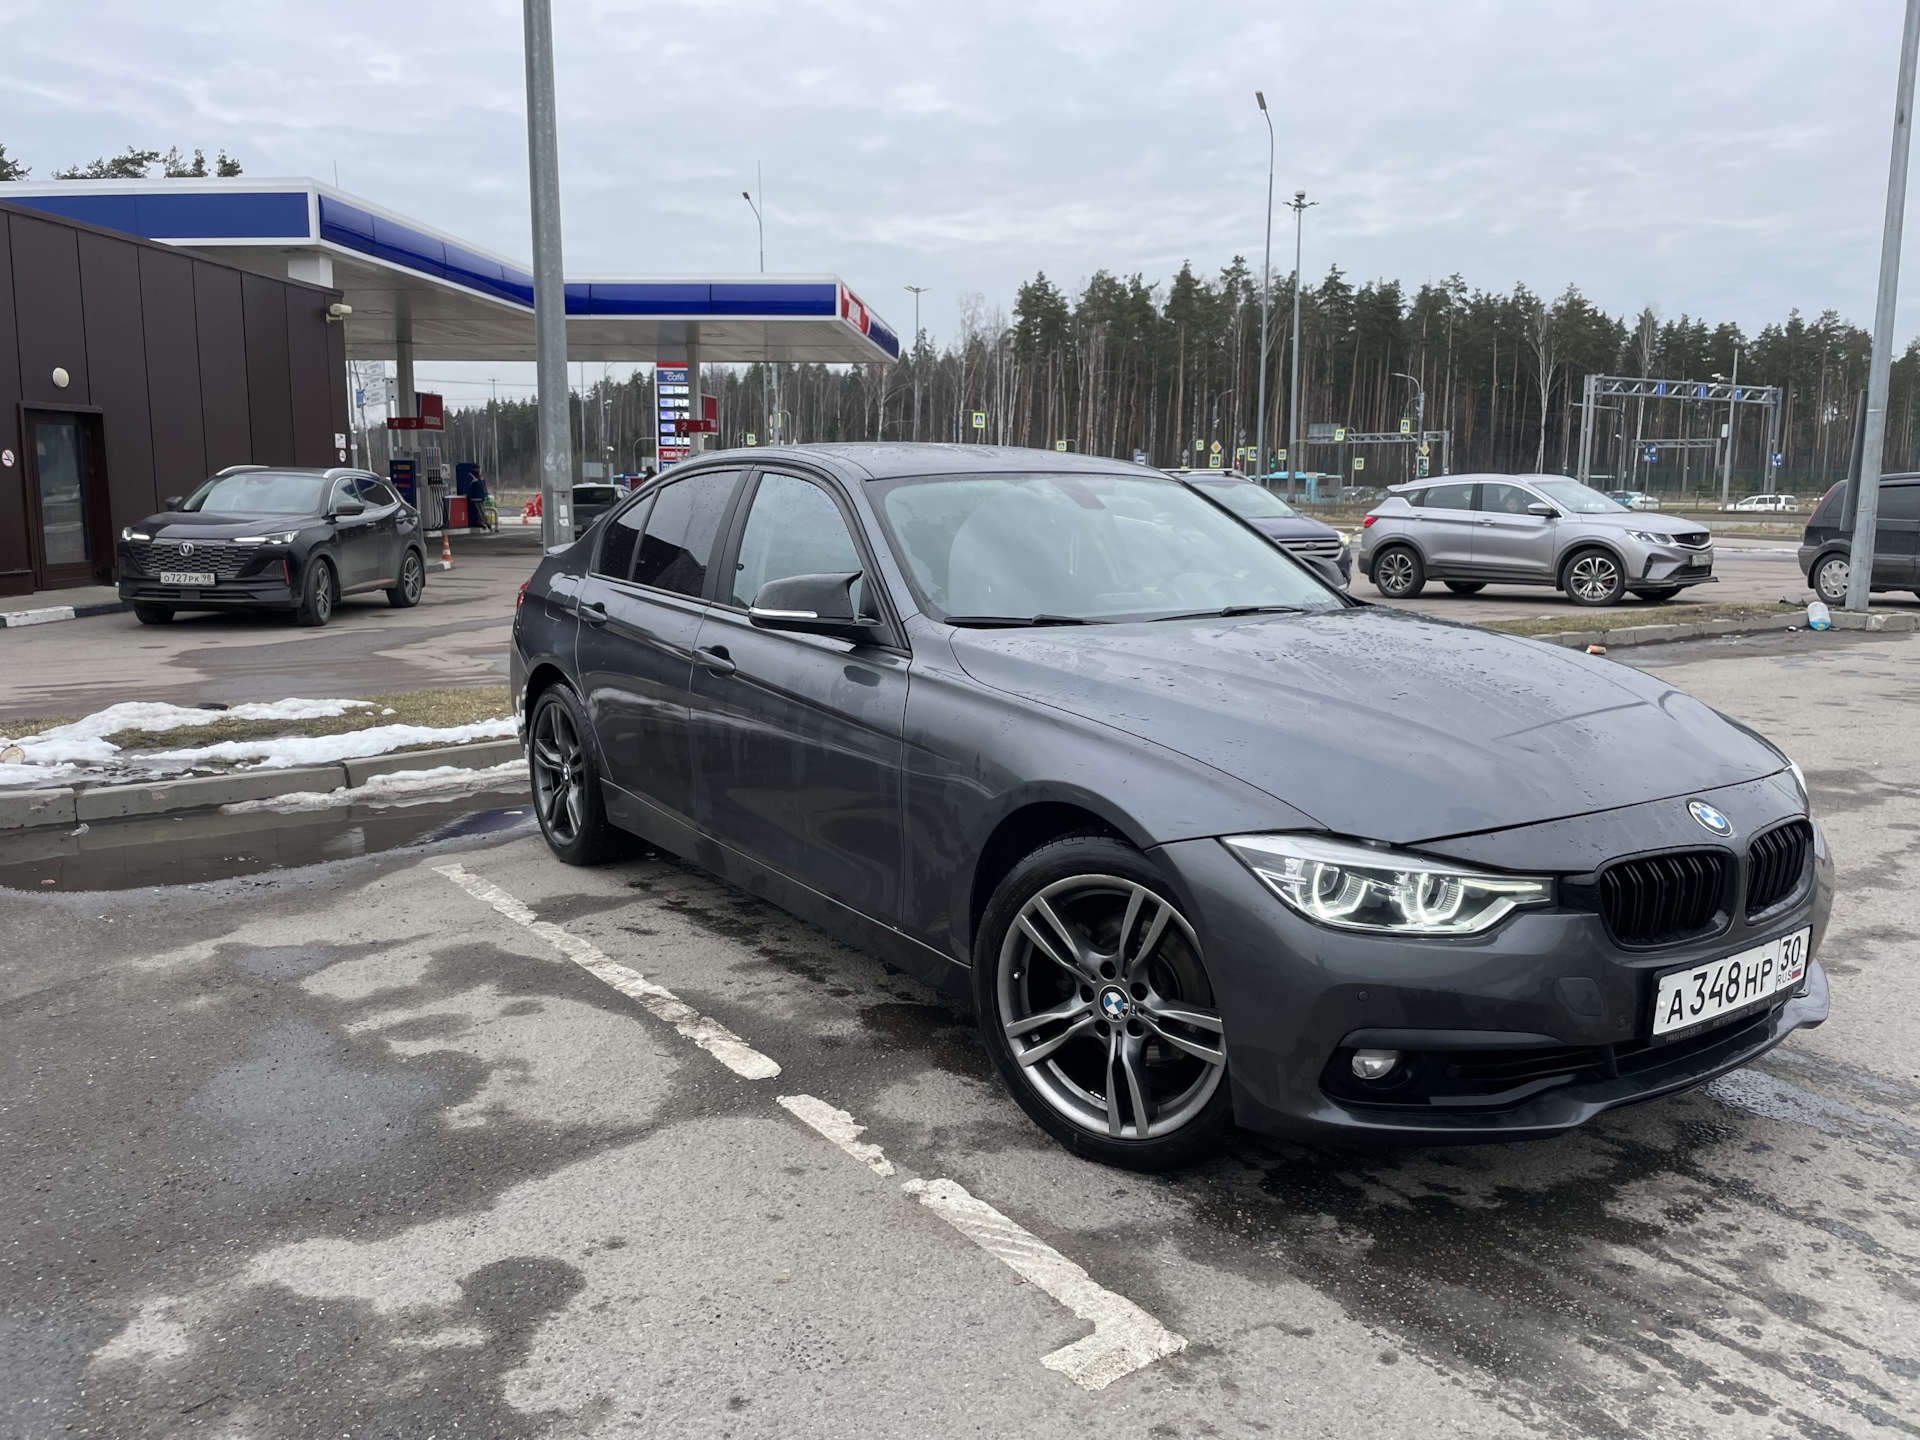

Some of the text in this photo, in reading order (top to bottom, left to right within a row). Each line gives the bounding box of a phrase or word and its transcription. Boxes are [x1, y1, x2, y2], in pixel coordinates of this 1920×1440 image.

[410, 420, 417, 428] 3
[681, 422, 688, 430] 2
[1781, 936, 1801, 971] 30
[1777, 969, 1792, 985] RUS
